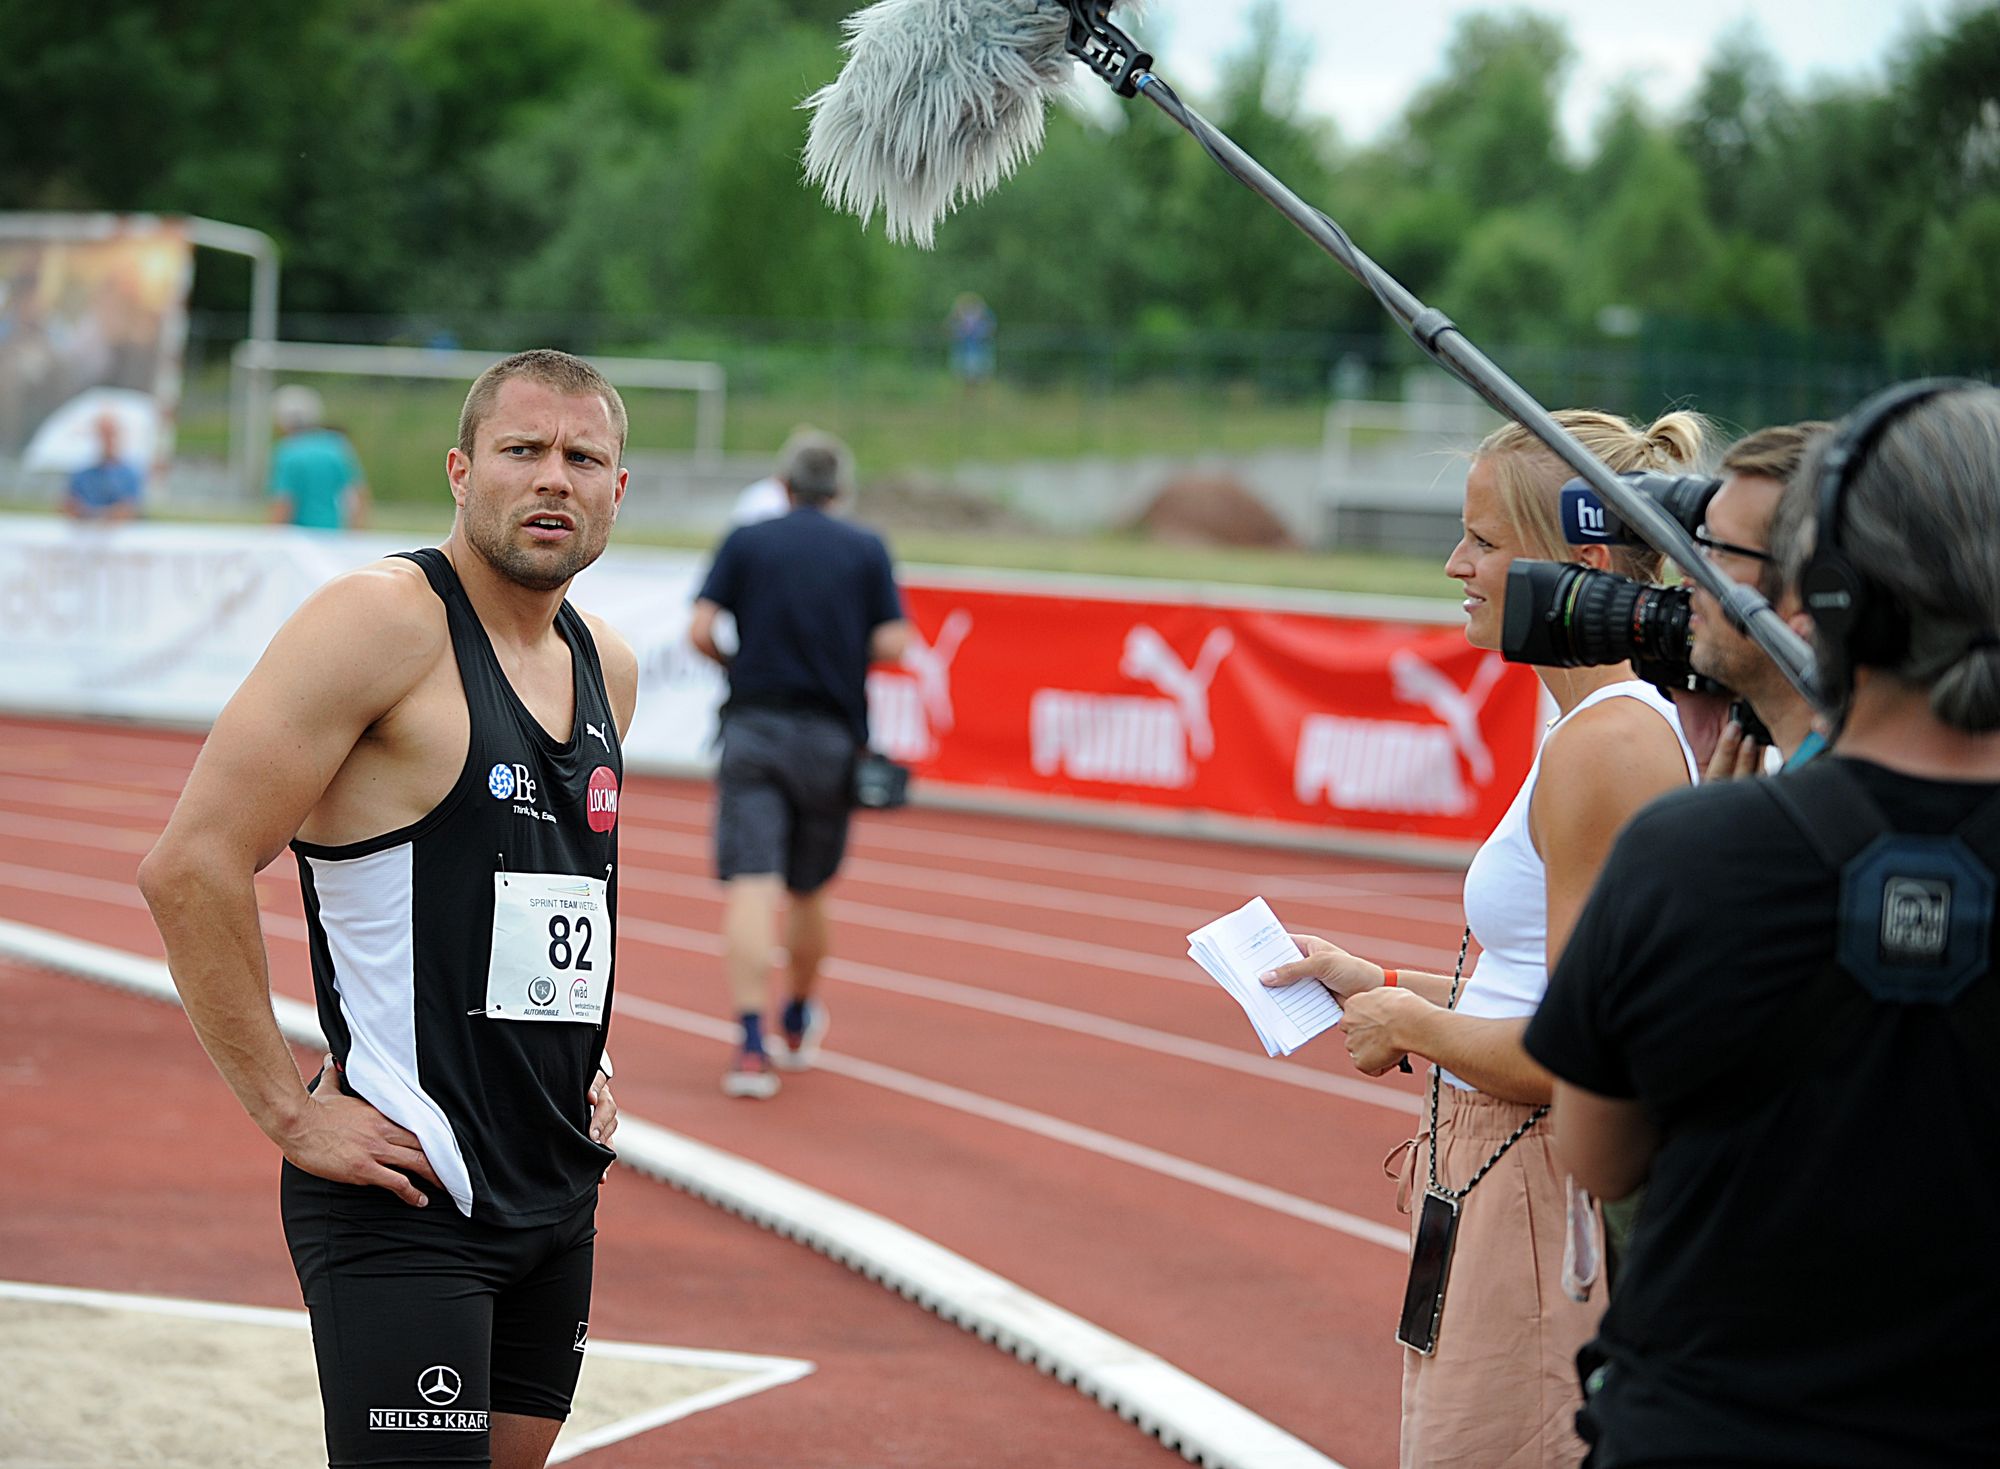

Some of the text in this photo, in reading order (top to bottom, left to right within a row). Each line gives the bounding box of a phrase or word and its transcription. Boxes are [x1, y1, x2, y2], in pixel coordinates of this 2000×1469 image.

[529, 898, 558, 909] SPRINT
[559, 899, 578, 909] TEAM
[548, 914, 593, 972] 82
[523, 1008, 560, 1017] AUTOMOBILE
[369, 1411, 429, 1428] NEILS
[432, 1414, 442, 1426] &
